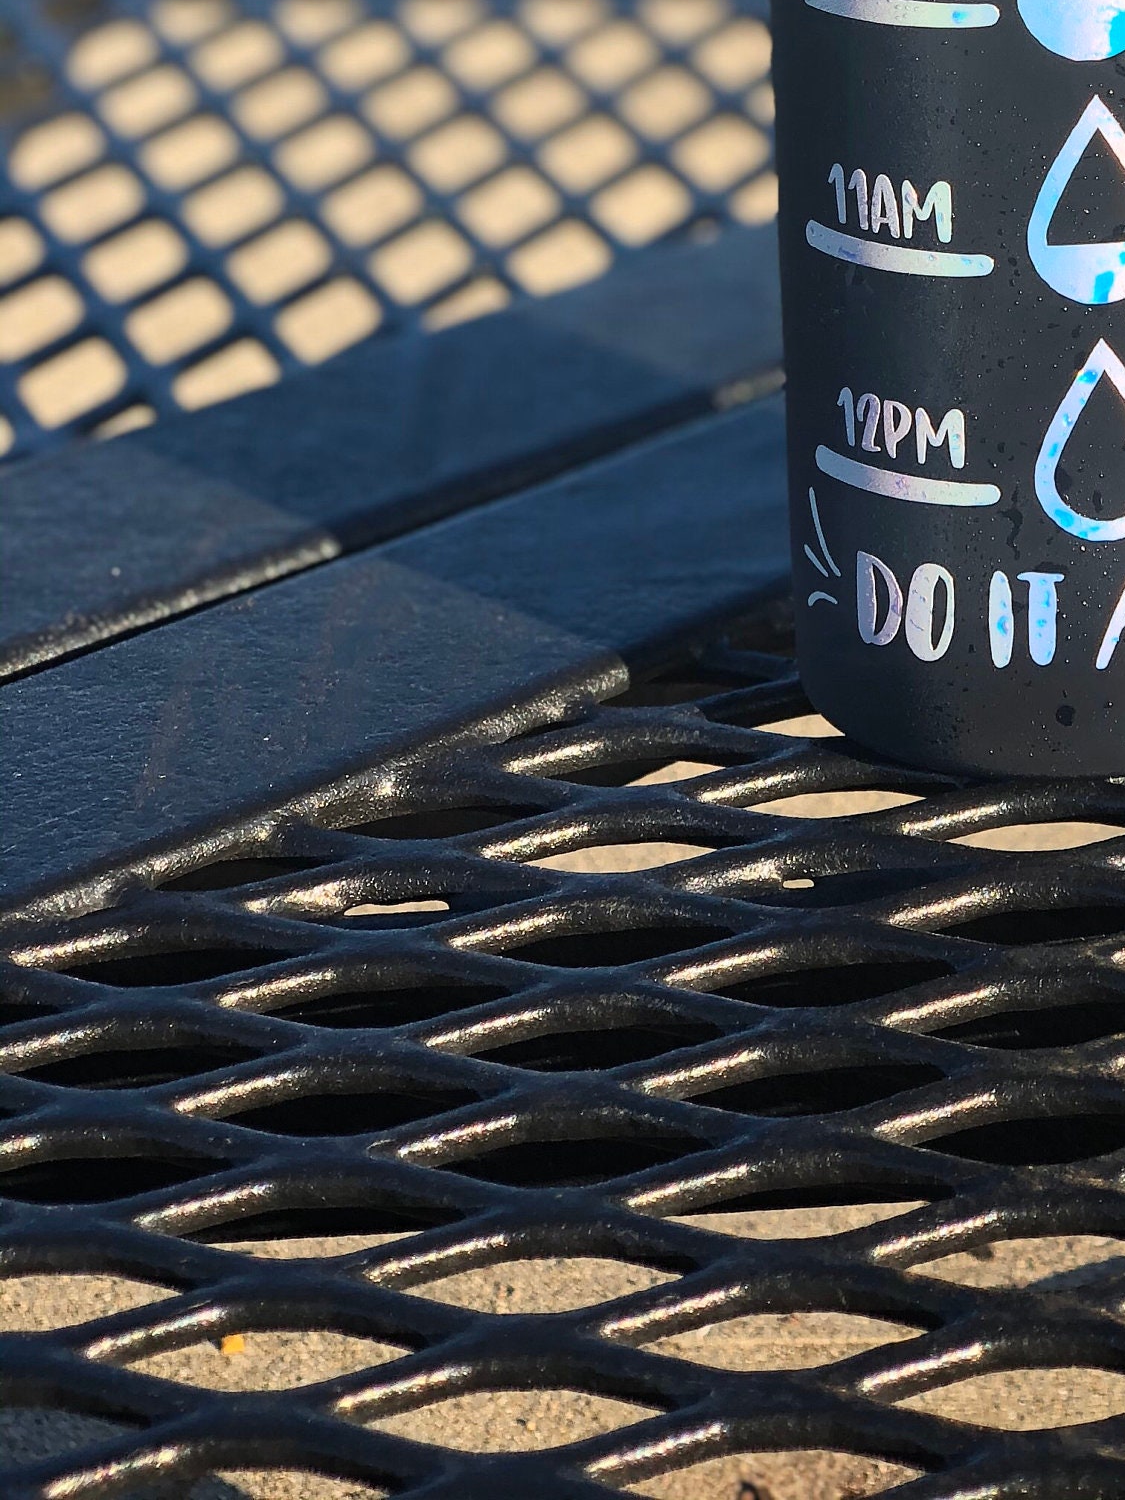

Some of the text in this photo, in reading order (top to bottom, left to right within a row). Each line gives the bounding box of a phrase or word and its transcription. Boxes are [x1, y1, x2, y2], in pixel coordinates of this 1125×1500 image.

[828, 163, 952, 244] 11AM
[837, 386, 966, 469] 12PM
[856, 550, 955, 662] DO
[989, 571, 1065, 669] IT
